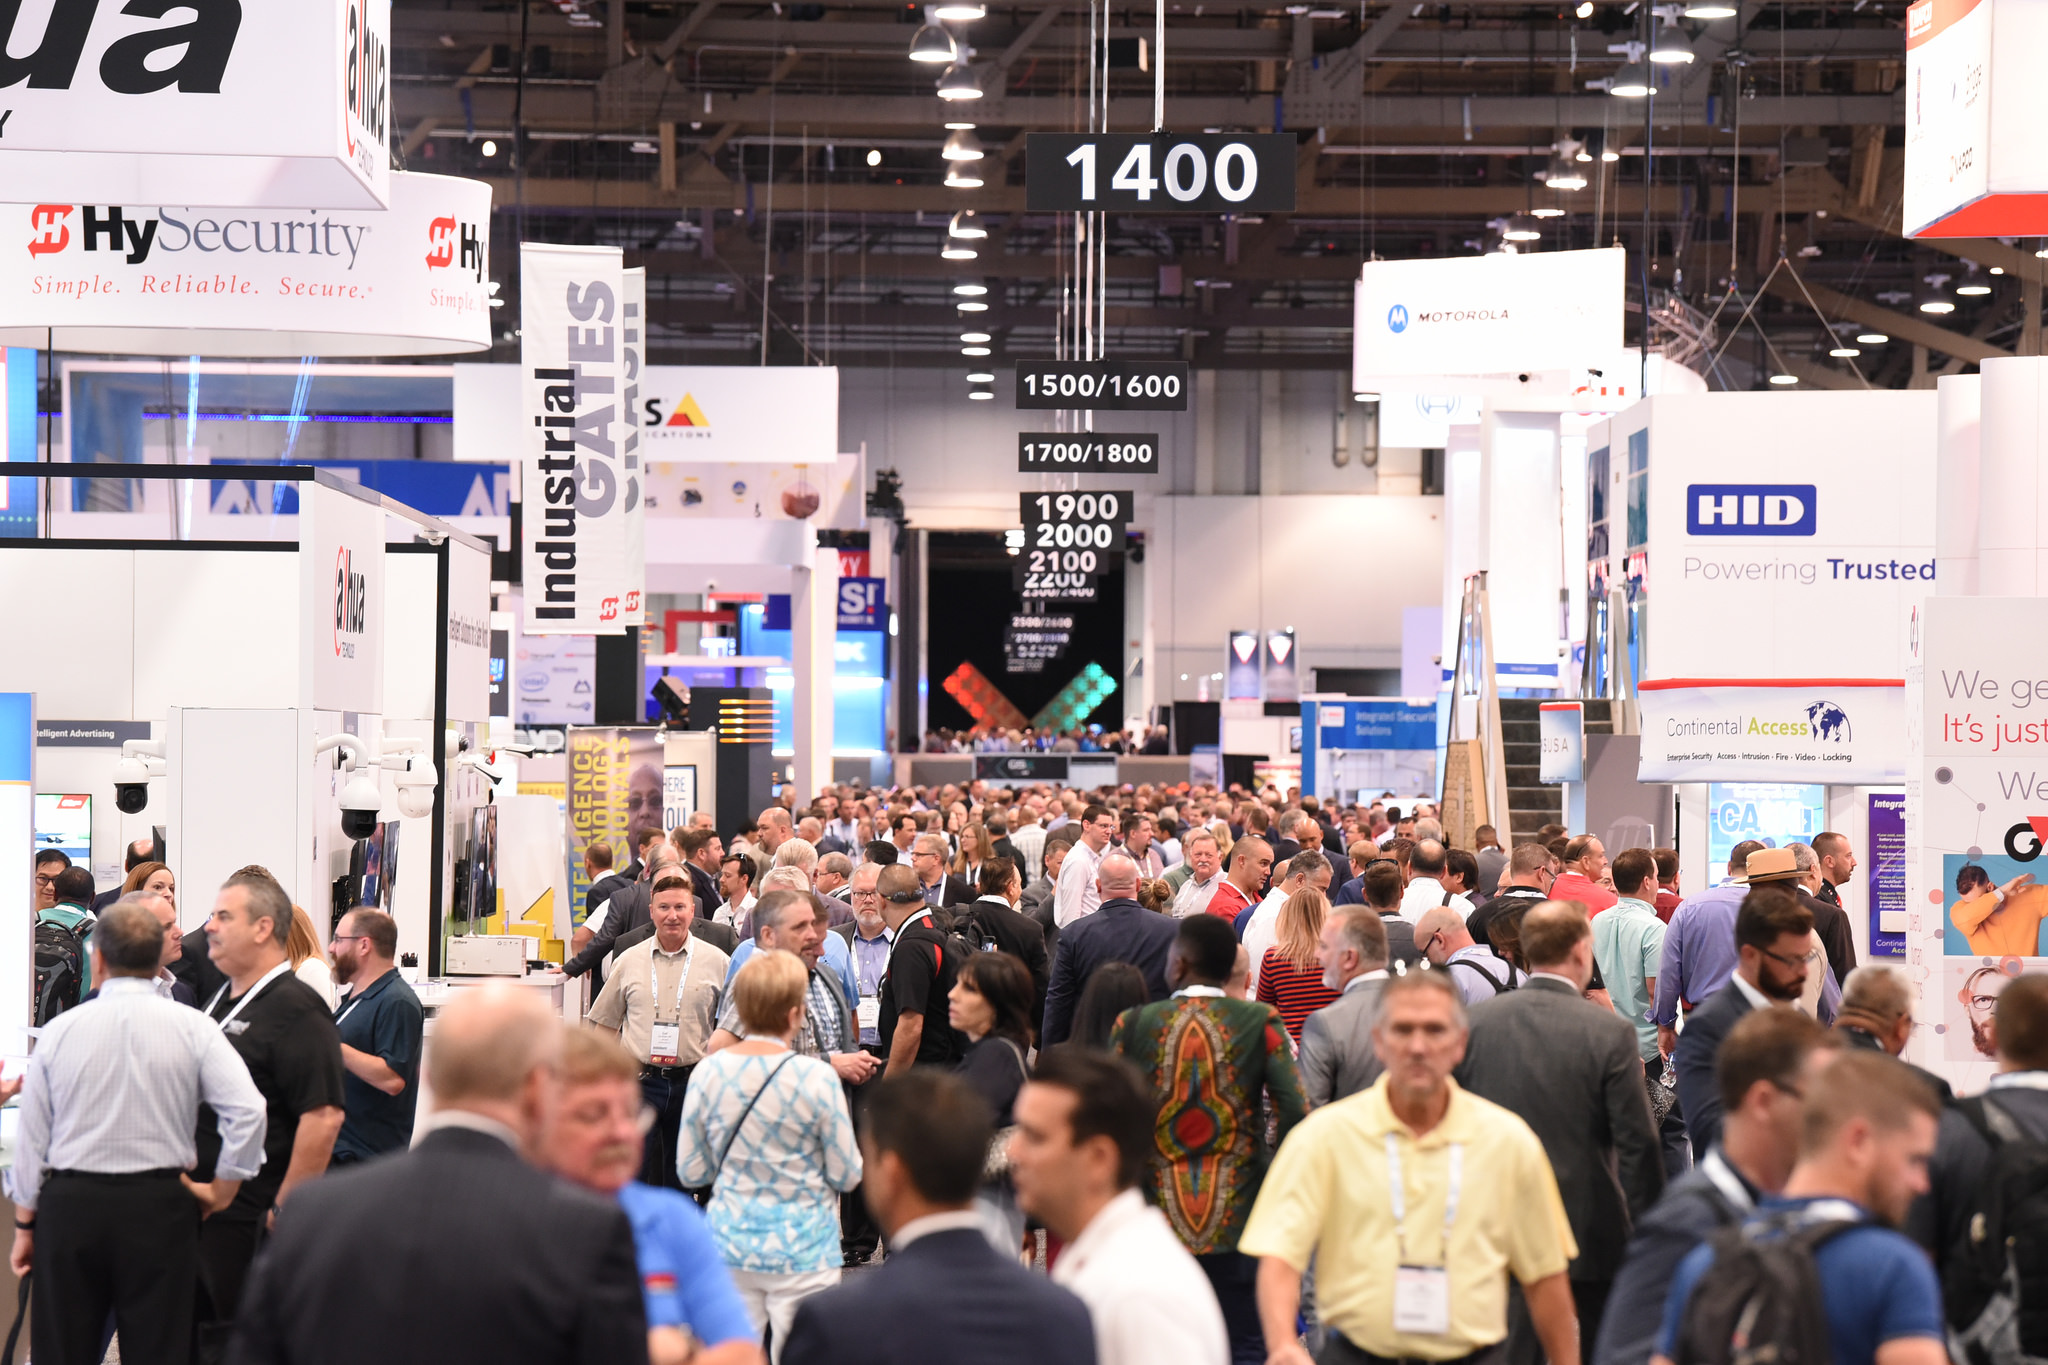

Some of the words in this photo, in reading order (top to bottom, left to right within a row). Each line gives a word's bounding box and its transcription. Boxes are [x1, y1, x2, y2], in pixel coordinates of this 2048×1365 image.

[1065, 142, 1258, 202] 1400
[32, 274, 121, 299] Simple.
[141, 273, 260, 294] Reliable.
[279, 276, 365, 299] Secure.
[1418, 309, 1510, 323] MOTOROLA
[566, 280, 617, 518] GATES
[1024, 374, 1180, 398] 1500/1600
[1023, 443, 1152, 464] 1700/1800
[535, 368, 577, 620] Industrial
[1035, 493, 1119, 521] 1900
[1698, 495, 1805, 526] HID
[1036, 522, 1113, 549] 2000
[1029, 550, 1097, 573] 2100
[1684, 557, 1817, 585] Powering
[1827, 558, 1937, 580] Trusted
[1942, 670, 1999, 700] We
[70, 729, 115, 739] Advertising
[1667, 716, 1742, 738] Continental
[1747, 716, 1808, 736] Access
[1691, 752, 1713, 762] Security
[1741, 752, 1770, 761] Intrusion
[1776, 753, 1789, 761] Fire
[1795, 753, 1816, 761] Video
[1822, 752, 1852, 762] Locking
